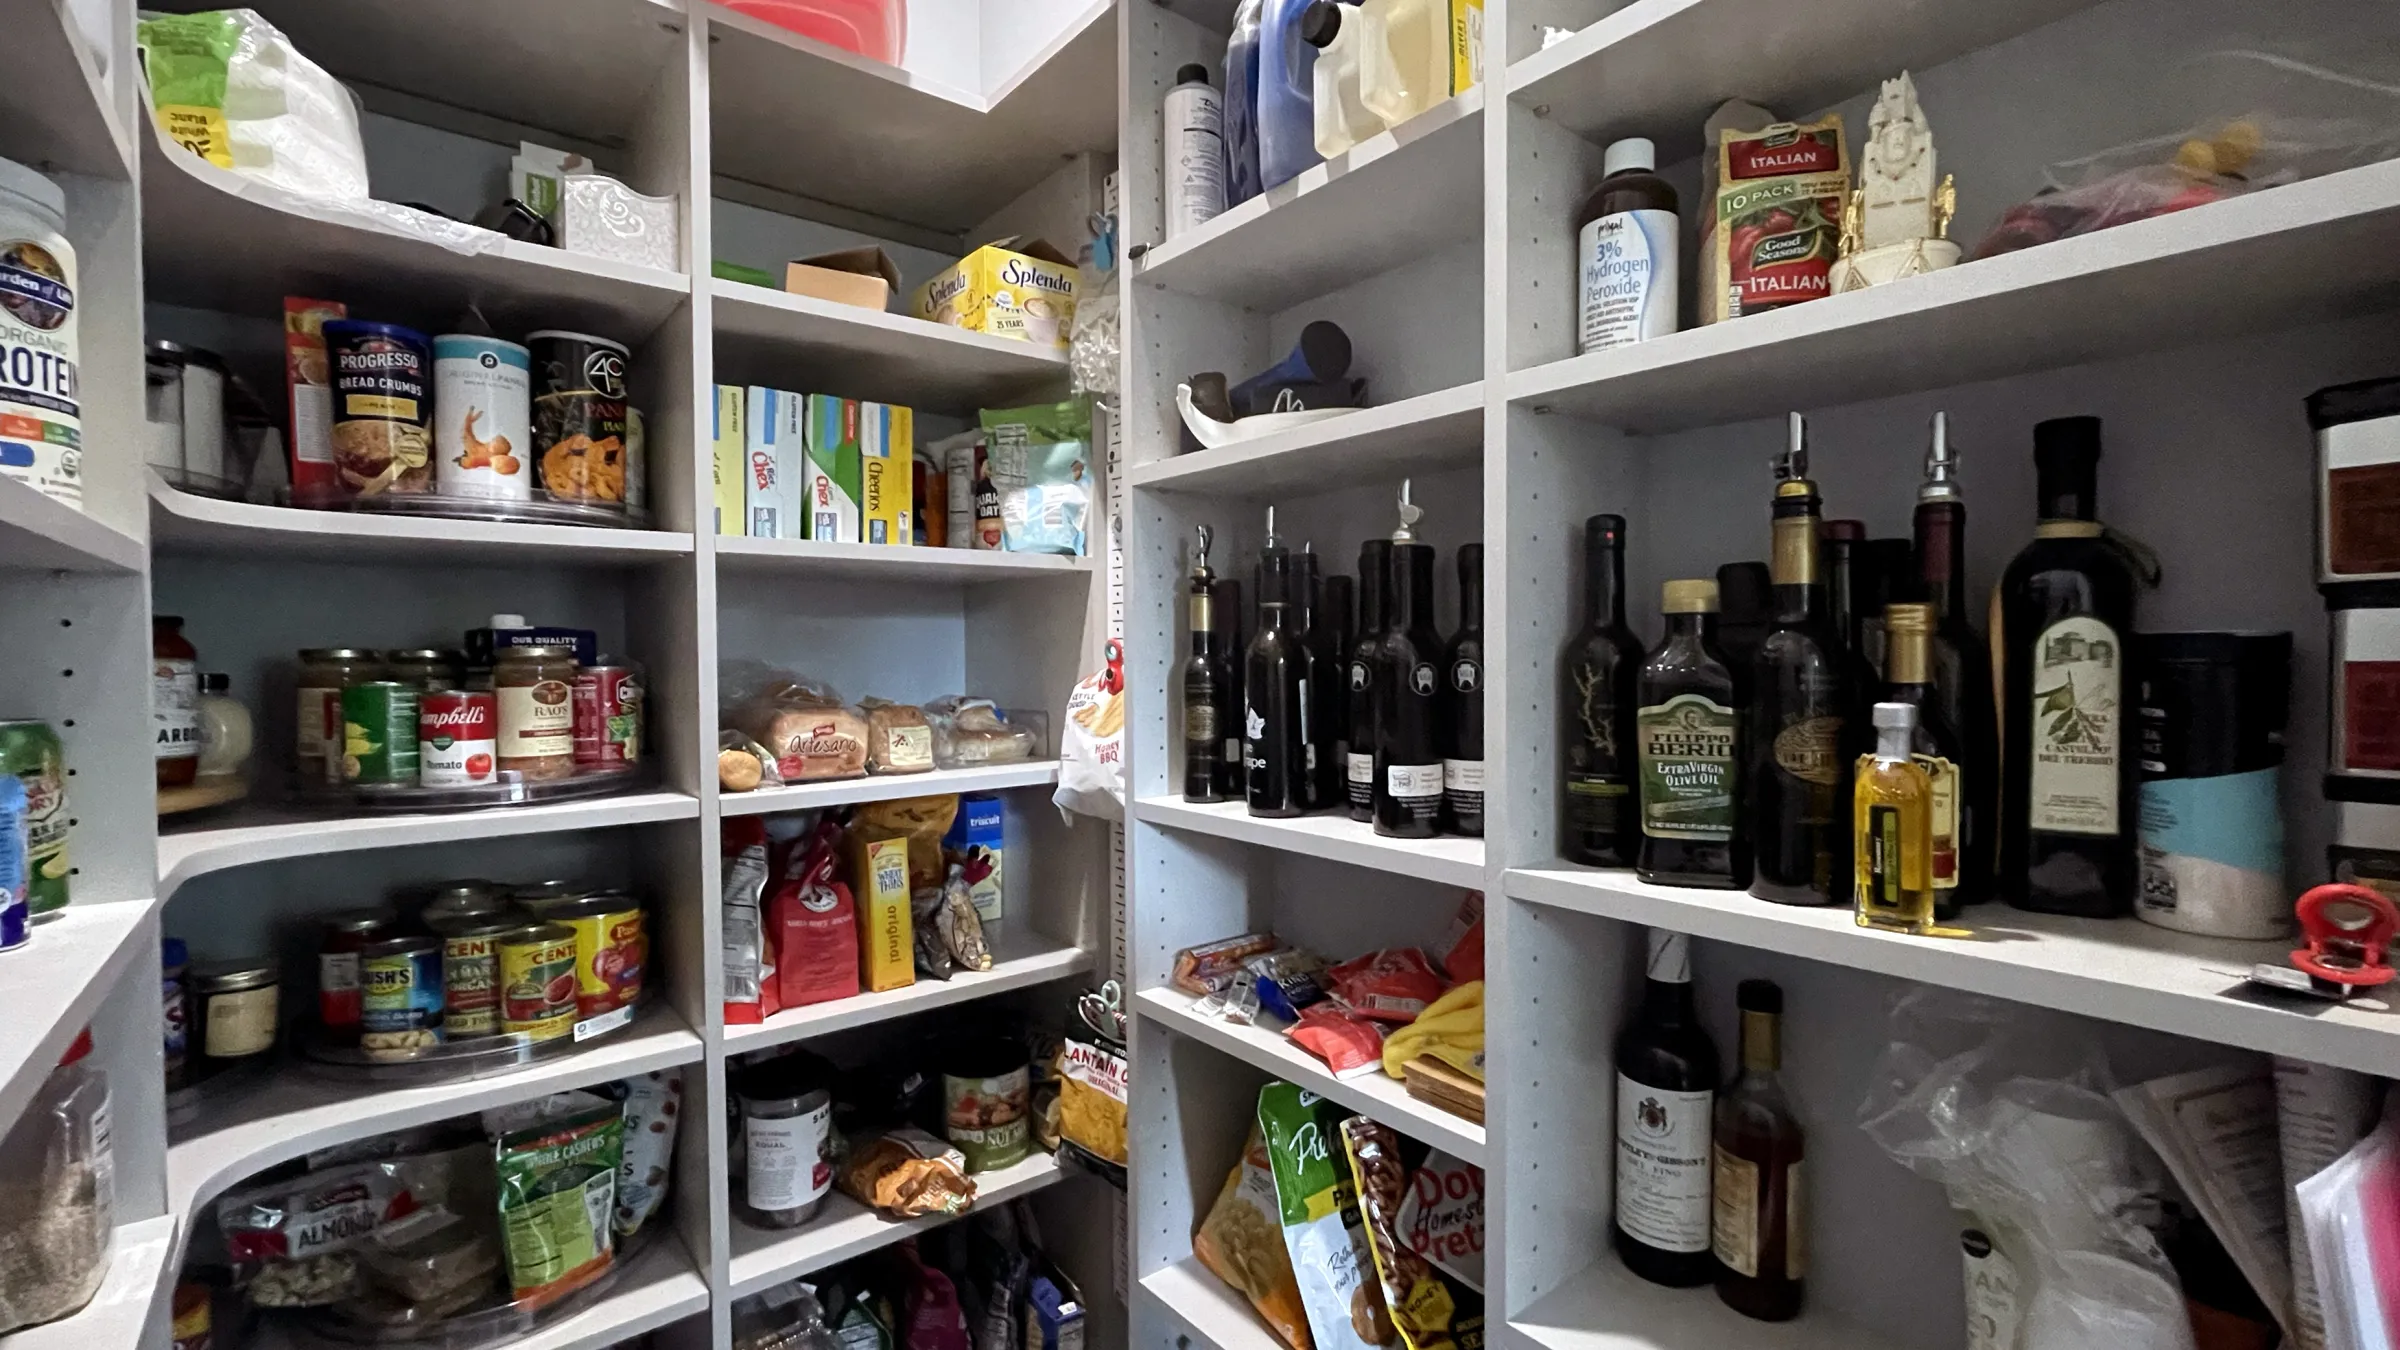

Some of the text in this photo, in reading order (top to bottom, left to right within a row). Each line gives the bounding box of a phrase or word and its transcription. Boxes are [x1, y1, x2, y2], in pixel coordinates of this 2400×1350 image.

[169, 113, 208, 125] Blanc
[169, 125, 211, 136] White
[1750, 152, 1817, 169] ITALIAN
[1726, 184, 1794, 213] 10 PACK
[1596, 240, 1622, 262] 3%
[1765, 235, 1802, 251] Good
[1758, 245, 1808, 262] Seasons
[1002, 258, 1073, 294] Splenda
[1586, 258, 1649, 284] Hydrogen
[924, 270, 967, 314] Splenda
[1586, 276, 1641, 305] Peroxide
[1750, 275, 1826, 293] ITALIAN
[997, 319, 1024, 329] 25 YEARS
[340, 352, 419, 369] PROGRESSO
[589, 356, 624, 394] 4C
[339, 377, 422, 396] BREAD CRUMBS
[752, 451, 772, 491] Chex
[766, 467, 776, 485] Rice
[815, 475, 830, 509] Chex
[868, 462, 884, 512] Cheerios
[977, 492, 999, 505] UAK
[980, 505, 1000, 517] OAT
[512, 636, 578, 645] OUR QUALITY
[420, 705, 485, 729] ampbell's
[534, 706, 568, 717] RAO'S
[790, 735, 857, 753] Artesano
[1653, 733, 1731, 743] FILIPPO
[1095, 740, 1120, 754] Honey
[1648, 743, 1735, 757] BERIO
[426, 760, 463, 770] Tomato
[1100, 750, 1120, 765] BBQ
[970, 814, 1000, 828] triscuit
[877, 868, 903, 880] WHEAT
[878, 879, 904, 894] THINS
[885, 905, 901, 965] original
[446, 940, 497, 958] CENT
[1277, 973, 1310, 990] KIND
[562, 1134, 605, 1160] CASHEWS
[1408, 1282, 1441, 1313] HONEY
